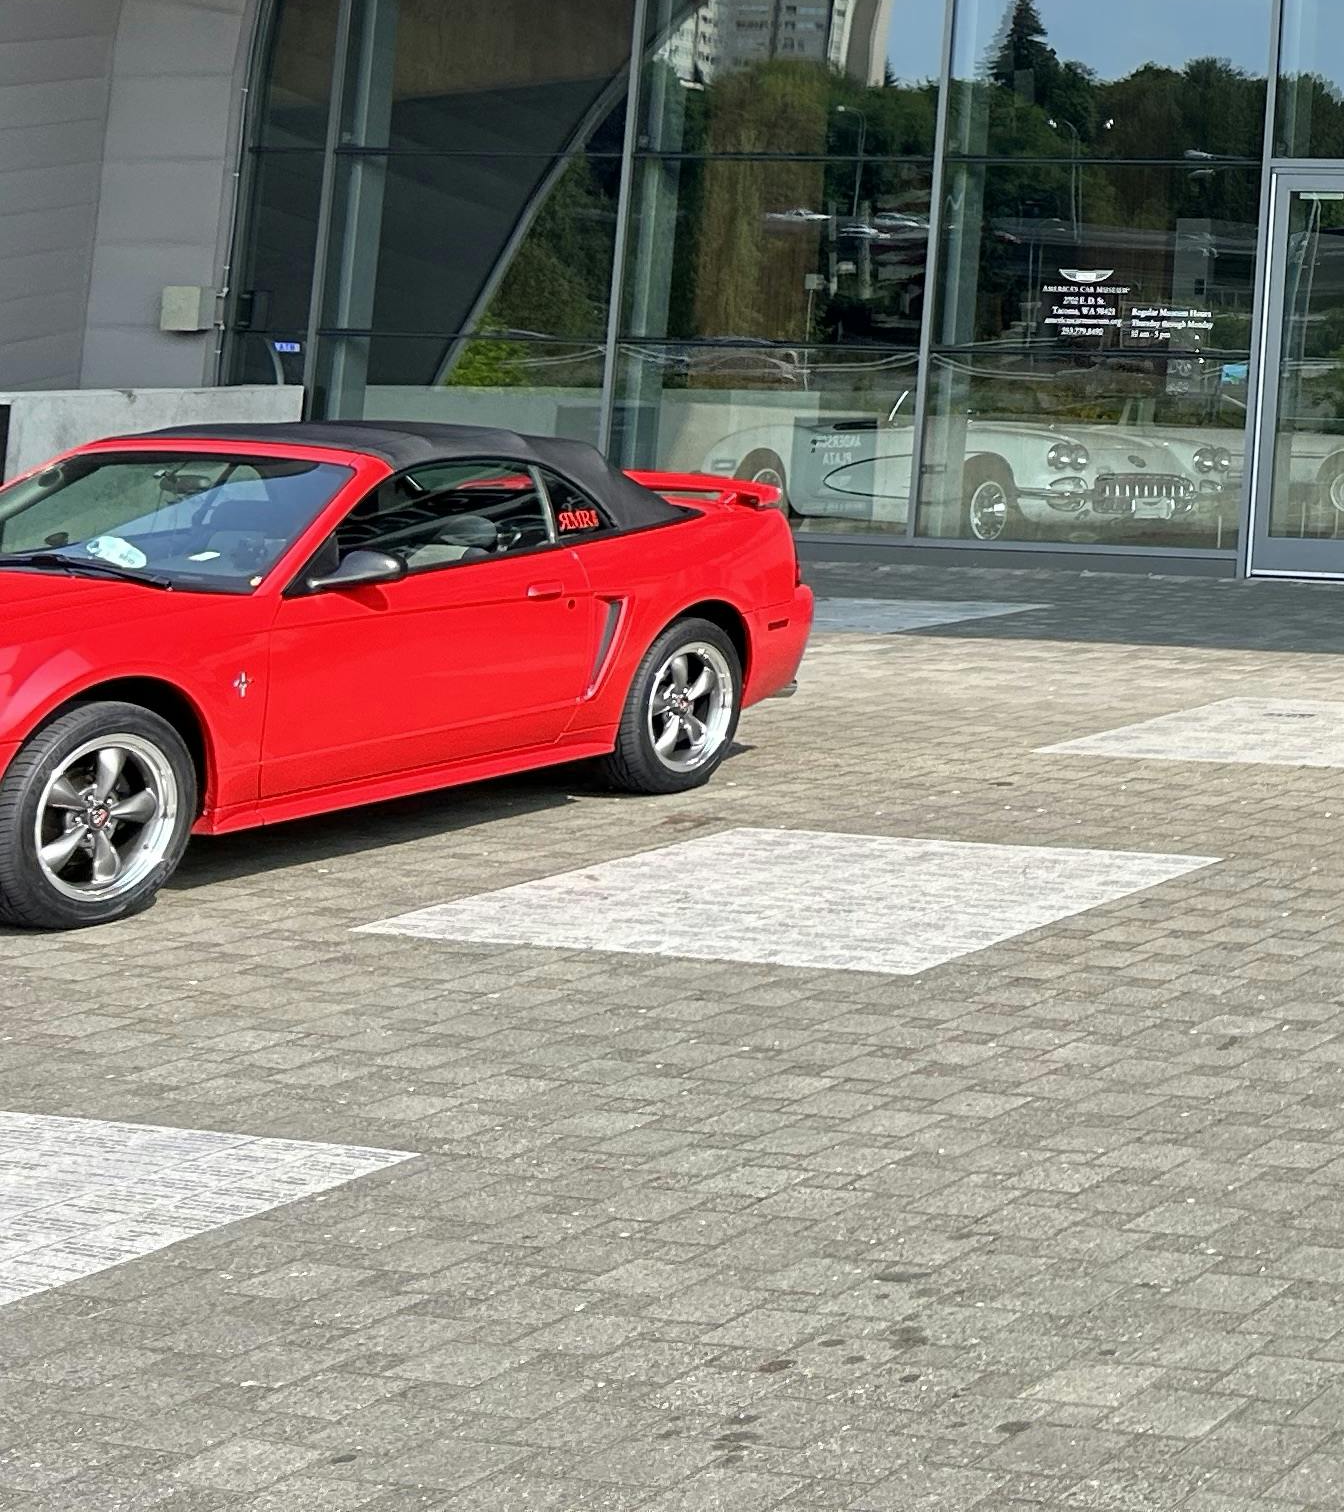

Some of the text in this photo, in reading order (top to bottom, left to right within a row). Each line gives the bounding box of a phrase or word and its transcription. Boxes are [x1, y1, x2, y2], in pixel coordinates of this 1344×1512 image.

[1081, 307, 1095, 315] WA
[1159, 308, 1188, 317] Museum
[1187, 320, 1214, 330] Monday
